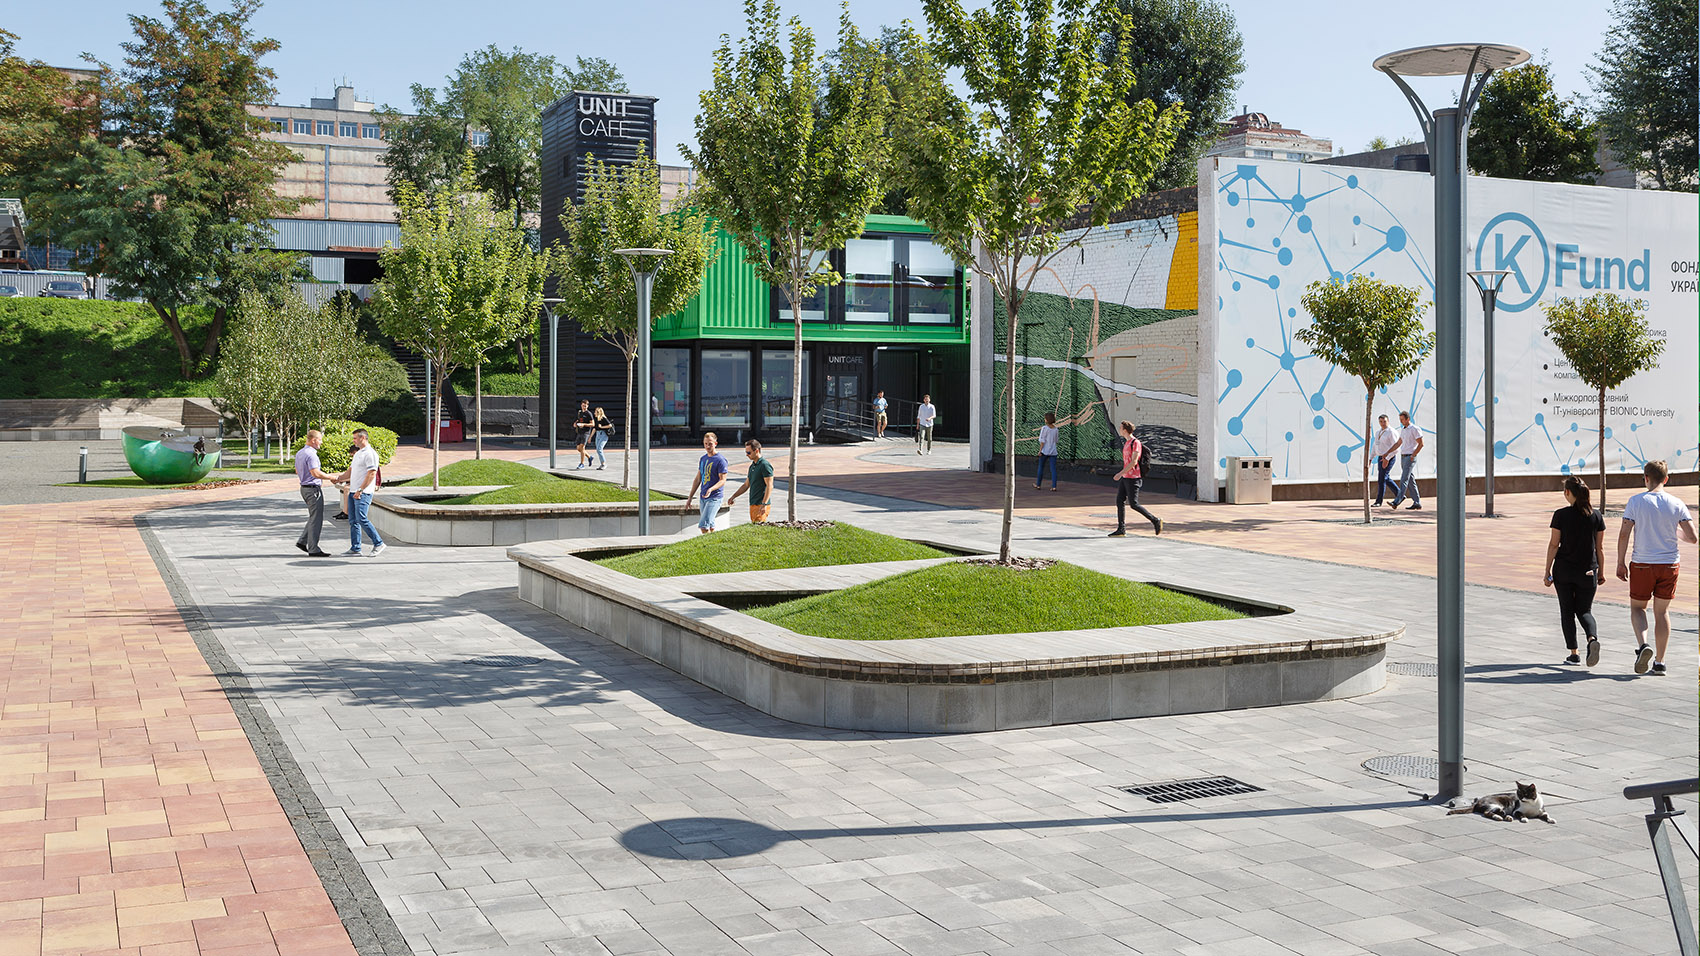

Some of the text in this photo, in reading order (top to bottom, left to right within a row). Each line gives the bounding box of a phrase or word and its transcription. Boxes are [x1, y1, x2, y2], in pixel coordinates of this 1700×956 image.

[579, 96, 631, 117] UNIT
[579, 117, 627, 137] CAFE
[1495, 233, 1650, 294] K Fund
[1553, 393, 1629, 404] Міжкорпоривний
[1553, 406, 1675, 419] ІТ-університт BIONIC University
